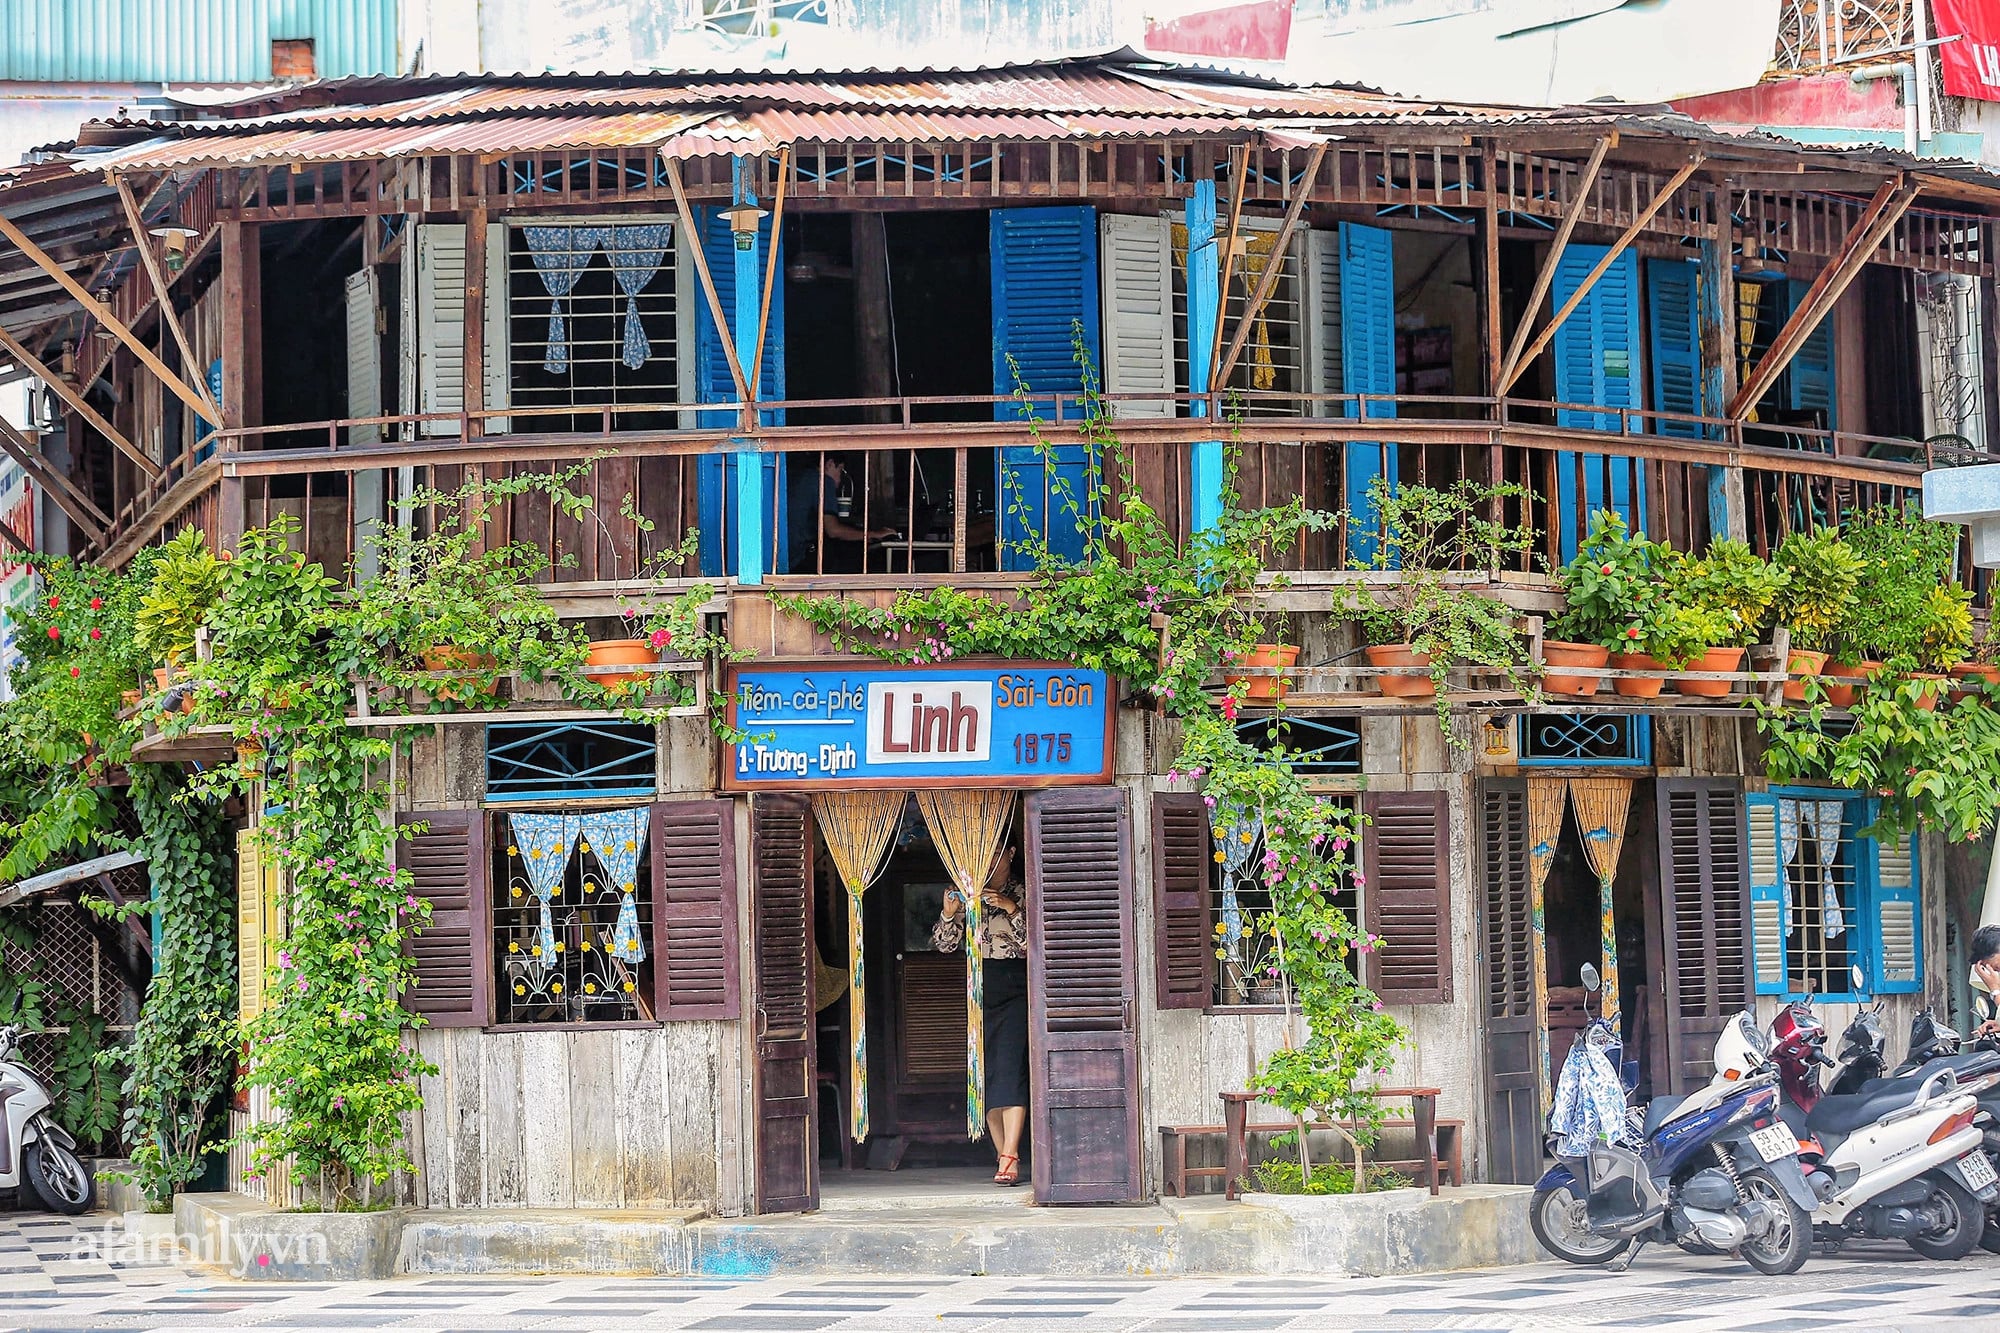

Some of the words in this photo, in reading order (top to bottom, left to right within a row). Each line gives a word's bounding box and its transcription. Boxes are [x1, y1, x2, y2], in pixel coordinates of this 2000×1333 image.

[997, 674, 1093, 709] Sài-Gòn
[882, 691, 979, 753] Linh
[1013, 731, 1073, 765] 1975
[1970, 1167, 1993, 1187] 7859
